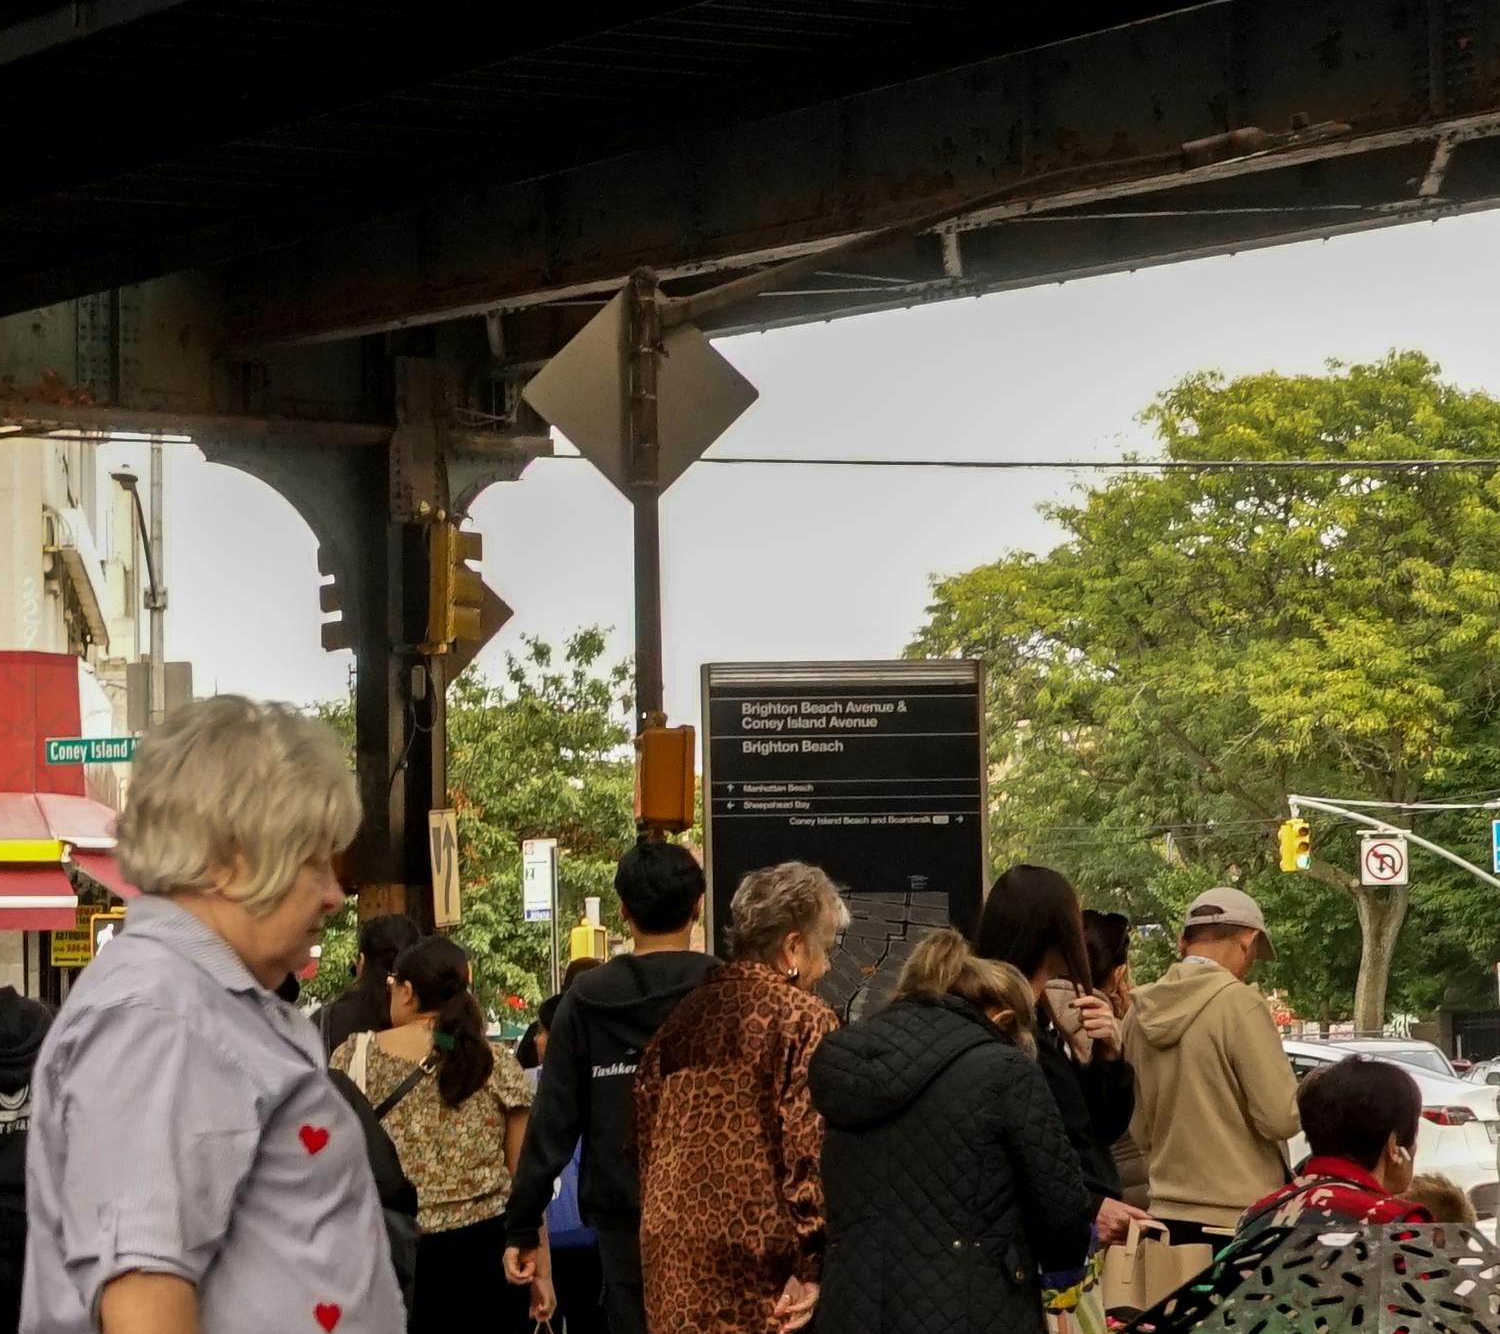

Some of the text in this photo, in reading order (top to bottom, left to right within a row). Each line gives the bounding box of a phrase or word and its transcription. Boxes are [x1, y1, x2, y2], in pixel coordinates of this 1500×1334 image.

[741, 700, 907, 717] Brighton Beach Avenue &
[741, 716, 878, 731] Coney Island Avenue
[50, 741, 88, 763] Coney
[91, 739, 129, 760] Island
[742, 740, 844, 755] Brighton Beach
[743, 783, 814, 793] Manhattan Beach
[743, 800, 810, 810] Sheepshead Bay
[789, 817, 816, 827] Coney
[817, 816, 842, 825] Island
[843, 816, 870, 825] Beach
[870, 816, 887, 824] and
[888, 815, 931, 824] Boardwalk
